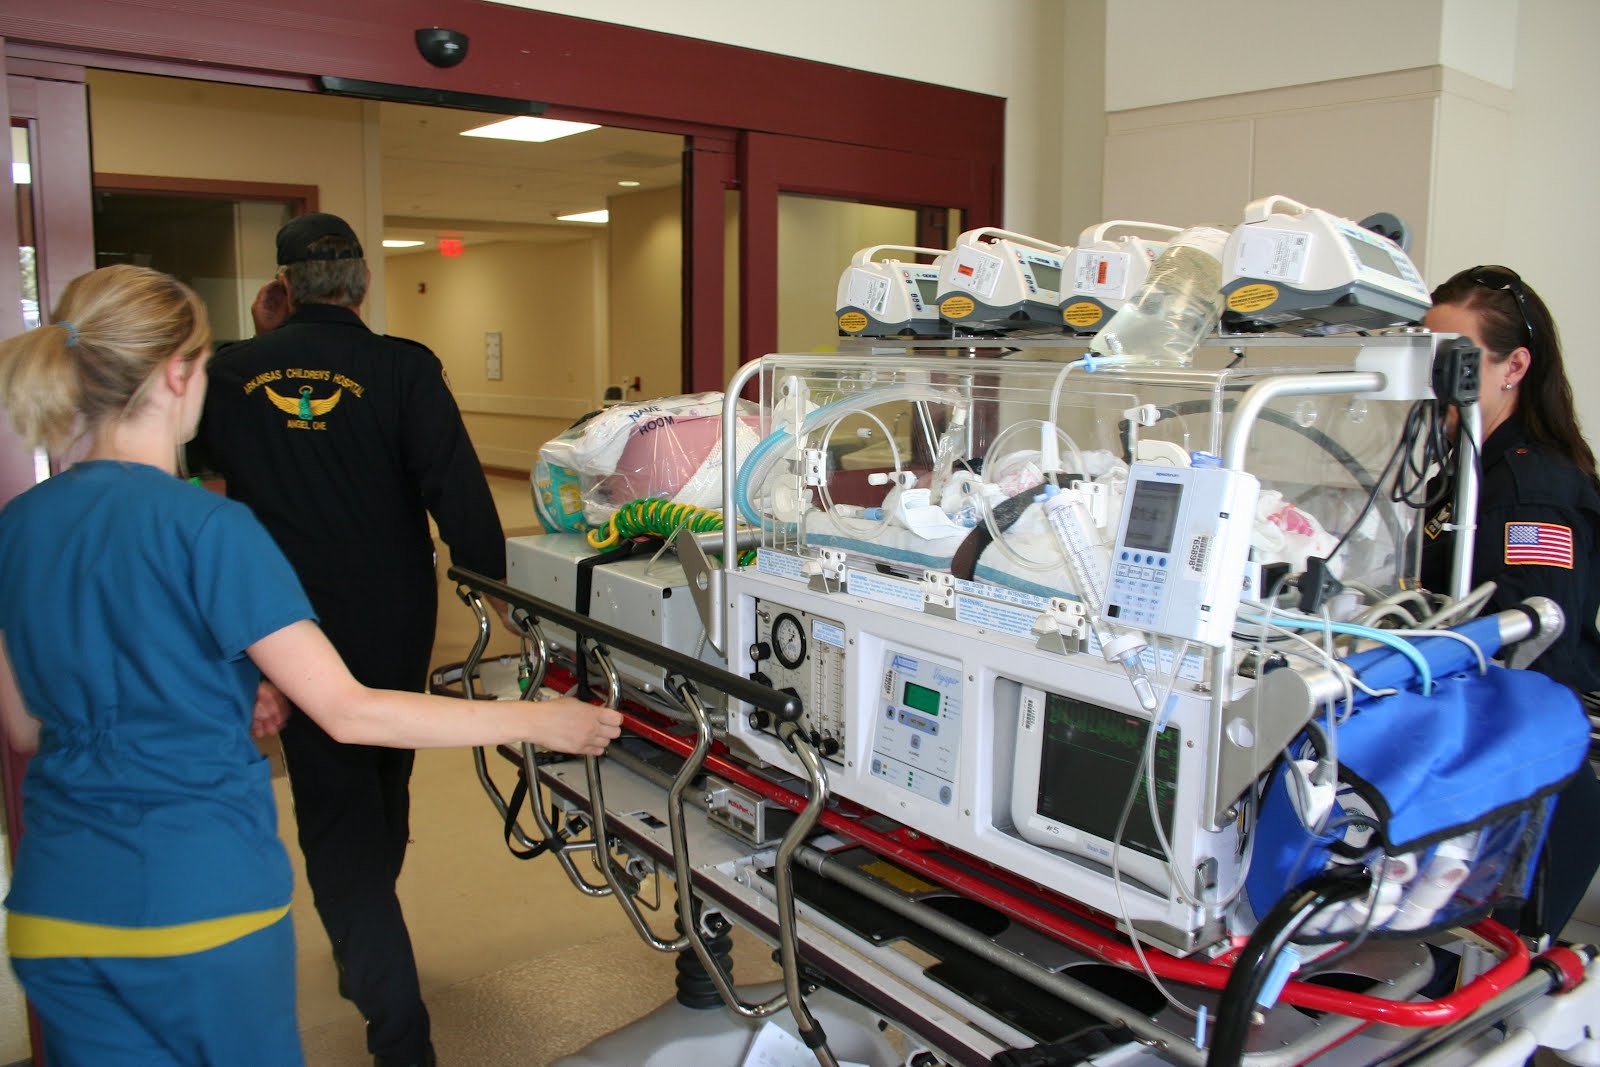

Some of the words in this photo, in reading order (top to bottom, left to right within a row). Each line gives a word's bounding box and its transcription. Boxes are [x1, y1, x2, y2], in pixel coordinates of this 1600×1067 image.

[243, 369, 282, 395] ARKANSAS
[286, 368, 330, 380] CHILDREN'S
[333, 373, 366, 398] HOSPITAL
[628, 406, 662, 422] NAME
[287, 420, 311, 430] ANGEL
[312, 421, 328, 430] ONE
[639, 416, 675, 436] ROOM
[1046, 825, 1060, 834] #5
